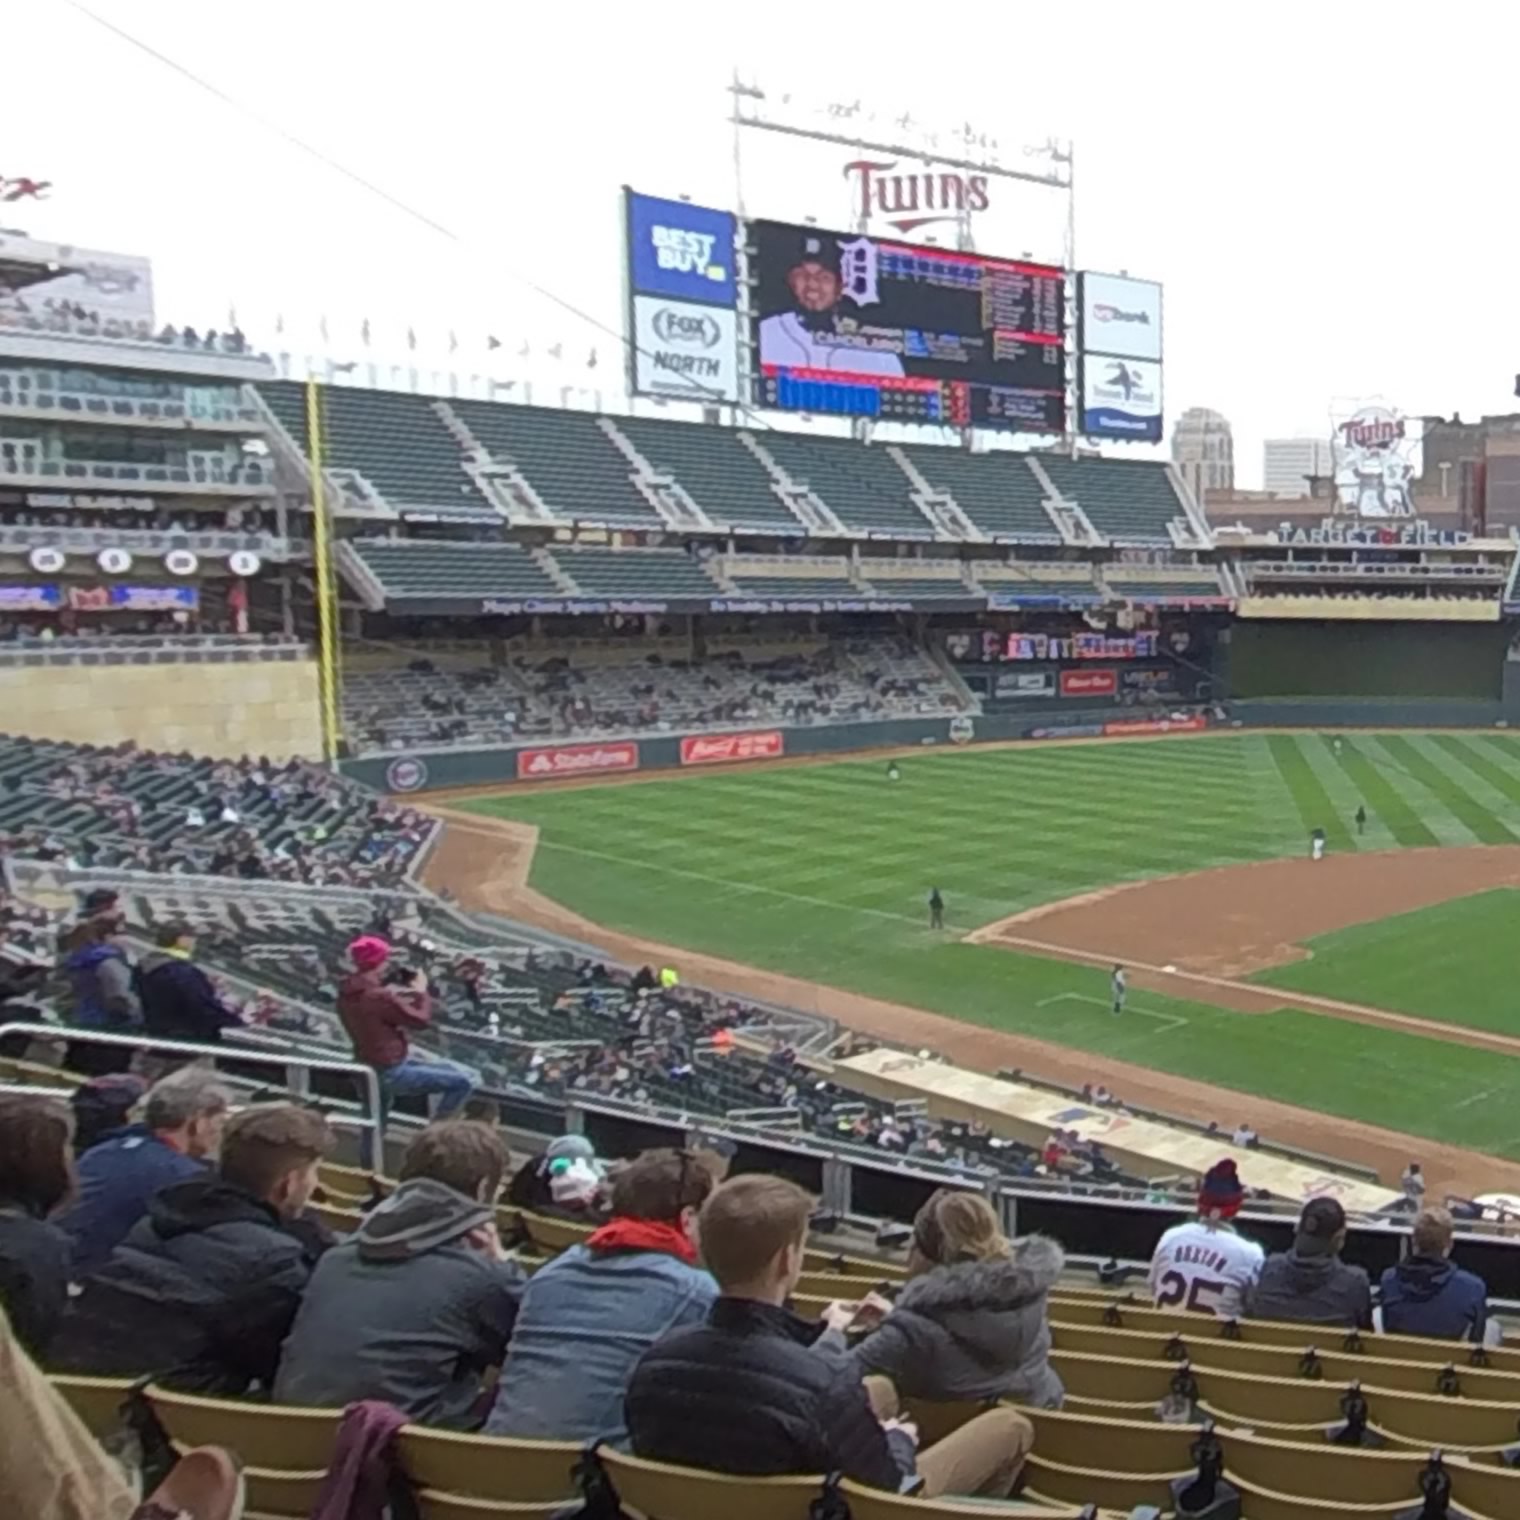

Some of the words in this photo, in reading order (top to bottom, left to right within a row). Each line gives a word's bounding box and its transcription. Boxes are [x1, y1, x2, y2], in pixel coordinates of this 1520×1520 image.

[843, 160, 990, 218] Twins
[652, 225, 716, 255] BEST
[657, 246, 707, 275] BUY
[666, 312, 706, 334] FOX
[653, 350, 721, 377] NORTH
[1339, 418, 1406, 448] Twins
[1278, 529, 1375, 546] TARGET
[1401, 529, 1474, 546] FIELD
[1156, 1269, 1226, 1316] 25
